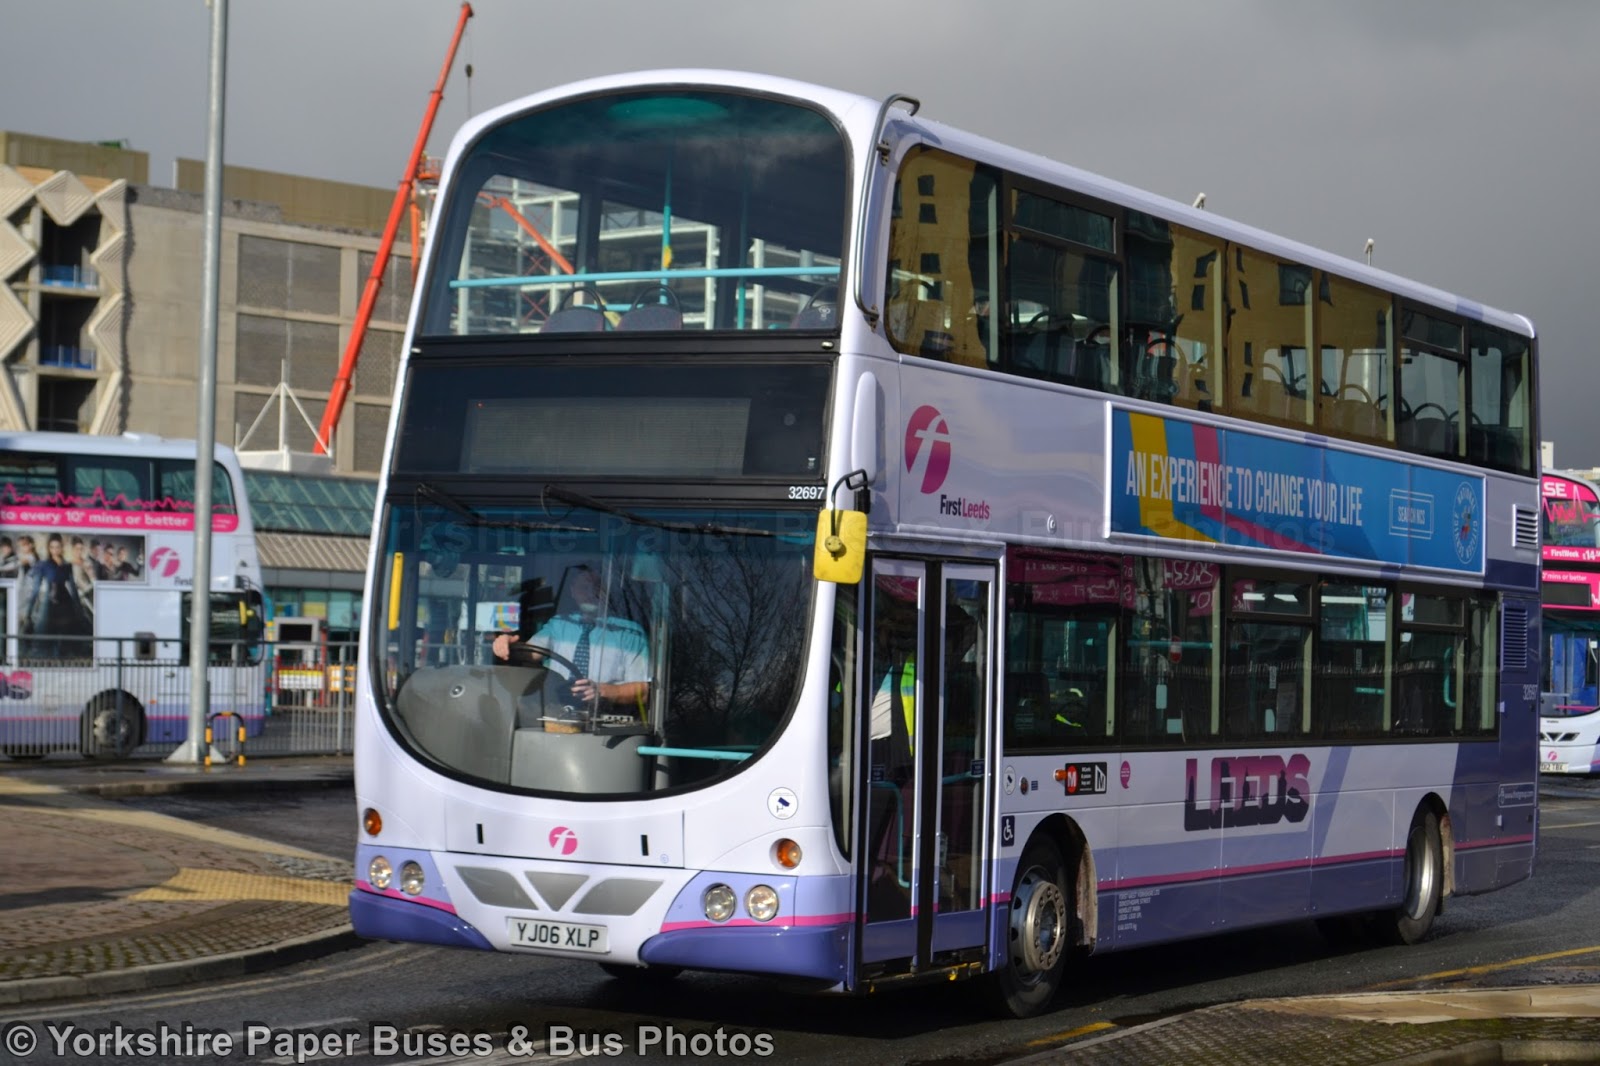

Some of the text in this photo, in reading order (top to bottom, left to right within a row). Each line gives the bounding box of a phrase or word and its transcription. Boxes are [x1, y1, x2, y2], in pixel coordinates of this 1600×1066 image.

[788, 486, 825, 500] 32697
[1126, 451, 1363, 526] AN EXPERIENCE TO CHANGE YOUR LIFE
[20, 512, 60, 524] every
[89, 514, 123, 525] mins
[125, 516, 141, 526] or
[144, 514, 189, 527] better
[1569, 573, 1587, 581] better
[517, 922, 599, 948] YJ06 XLP
